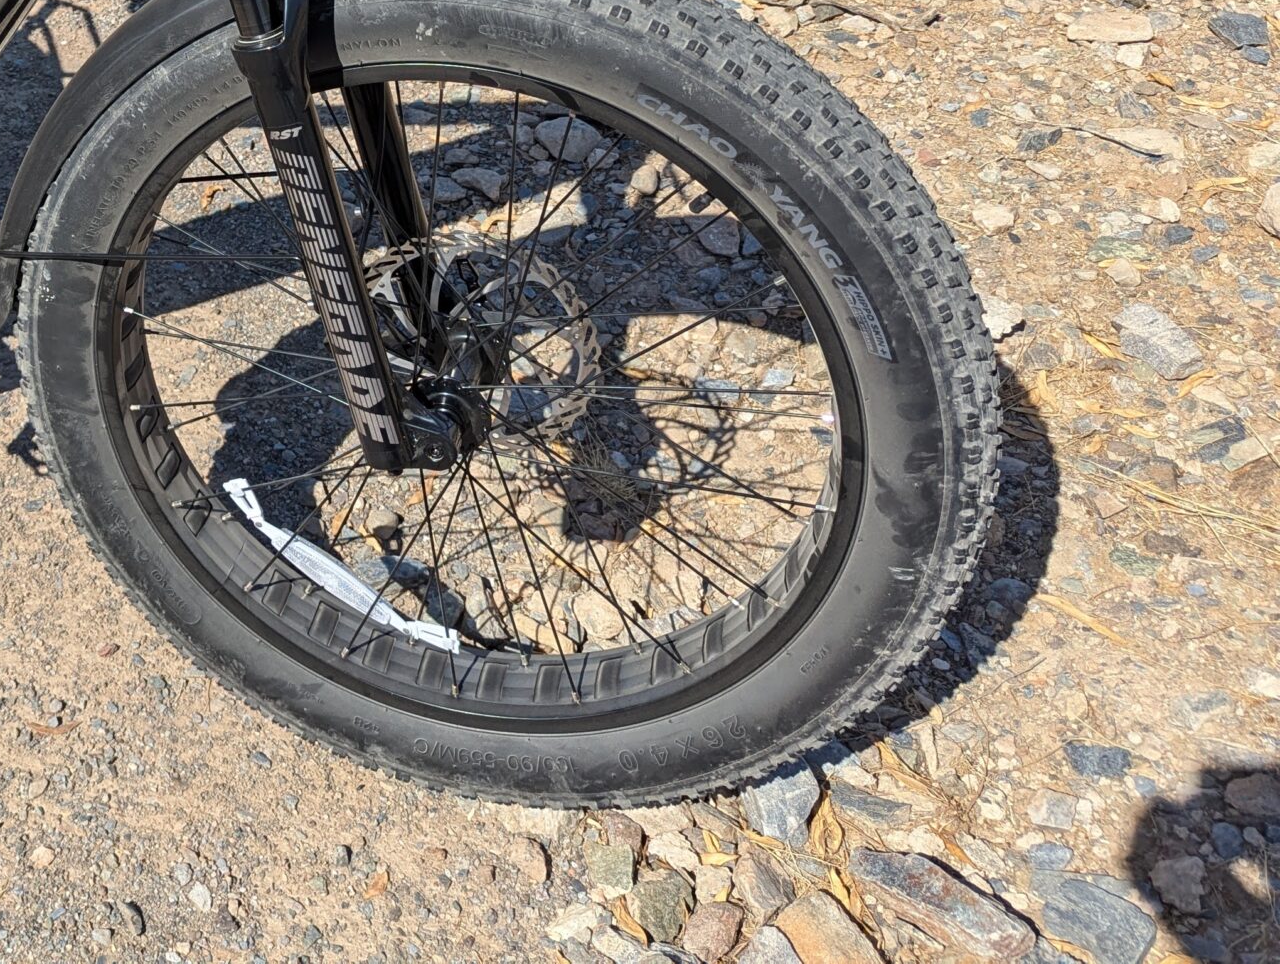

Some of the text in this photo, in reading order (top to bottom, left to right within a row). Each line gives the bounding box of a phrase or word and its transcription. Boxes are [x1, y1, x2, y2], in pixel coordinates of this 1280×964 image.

[341, 37, 402, 52] NYLON
[270, 126, 302, 141] RST
[634, 93, 845, 269] CHAO YANG
[275, 148, 399, 445] RENEGADE
[853, 289, 875, 321] HIPPO
[871, 323, 886, 346] SKIN
